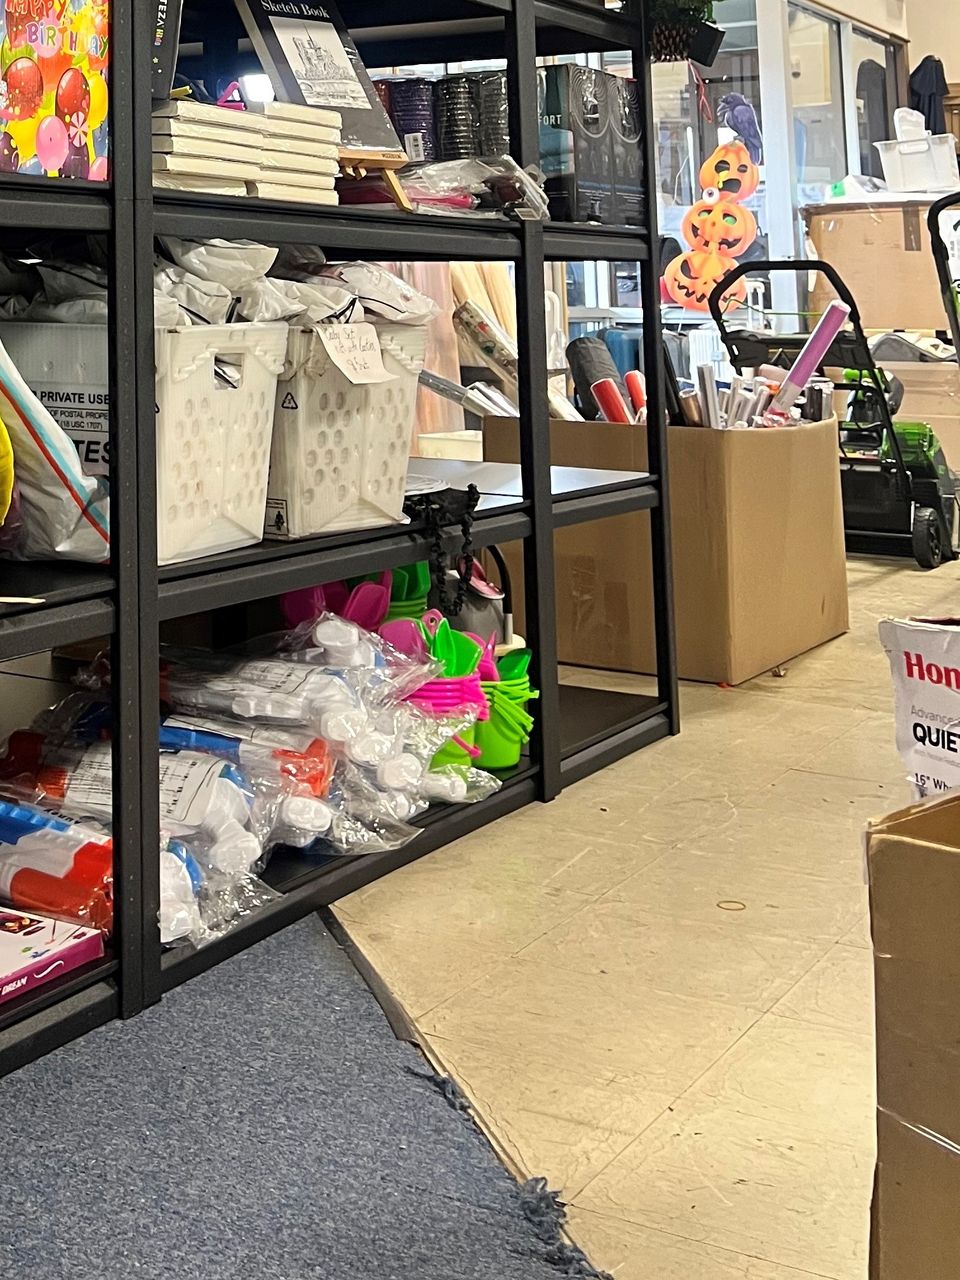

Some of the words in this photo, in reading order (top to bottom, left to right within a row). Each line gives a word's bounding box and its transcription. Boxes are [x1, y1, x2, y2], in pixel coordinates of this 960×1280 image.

[300, 3, 330, 19] Book
[40, 391, 85, 404] PRIVATE
[88, 394, 109, 405] USE
[60, 410, 84, 418] POSTAL
[71, 421, 85, 429] USC
[912, 722, 960, 753] QUIE
[915, 773, 930, 787] 16"
[1, 976, 28, 996] DREAM
